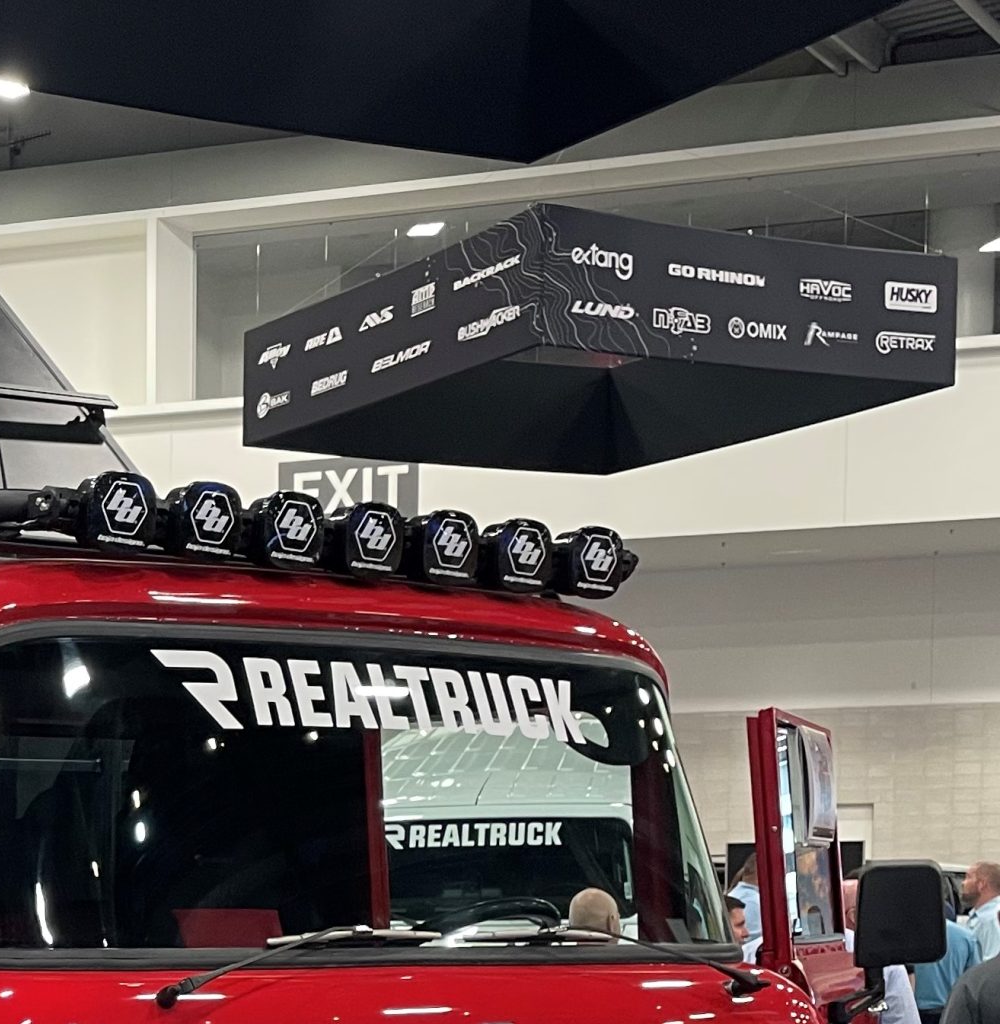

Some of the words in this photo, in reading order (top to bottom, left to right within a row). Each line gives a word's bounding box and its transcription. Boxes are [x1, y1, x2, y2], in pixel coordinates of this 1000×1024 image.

[453, 254, 520, 290] BACKRACK
[571, 243, 633, 281] extang
[668, 263, 695, 279] GO
[697, 267, 756, 286] RHINO
[800, 280, 852, 298] HAVOC
[890, 286, 932, 304] HUSKY
[358, 305, 394, 332] AVS
[457, 305, 520, 341] BUSHWACKER
[571, 300, 635, 319] LUND
[747, 322, 787, 341] OMIX
[876, 331, 936, 354] RETRAX
[371, 340, 432, 373] BELMOR
[293, 464, 410, 515] EXIT
[244, 658, 586, 745] REALTRUCK
[408, 821, 562, 848] REALTRUCK
